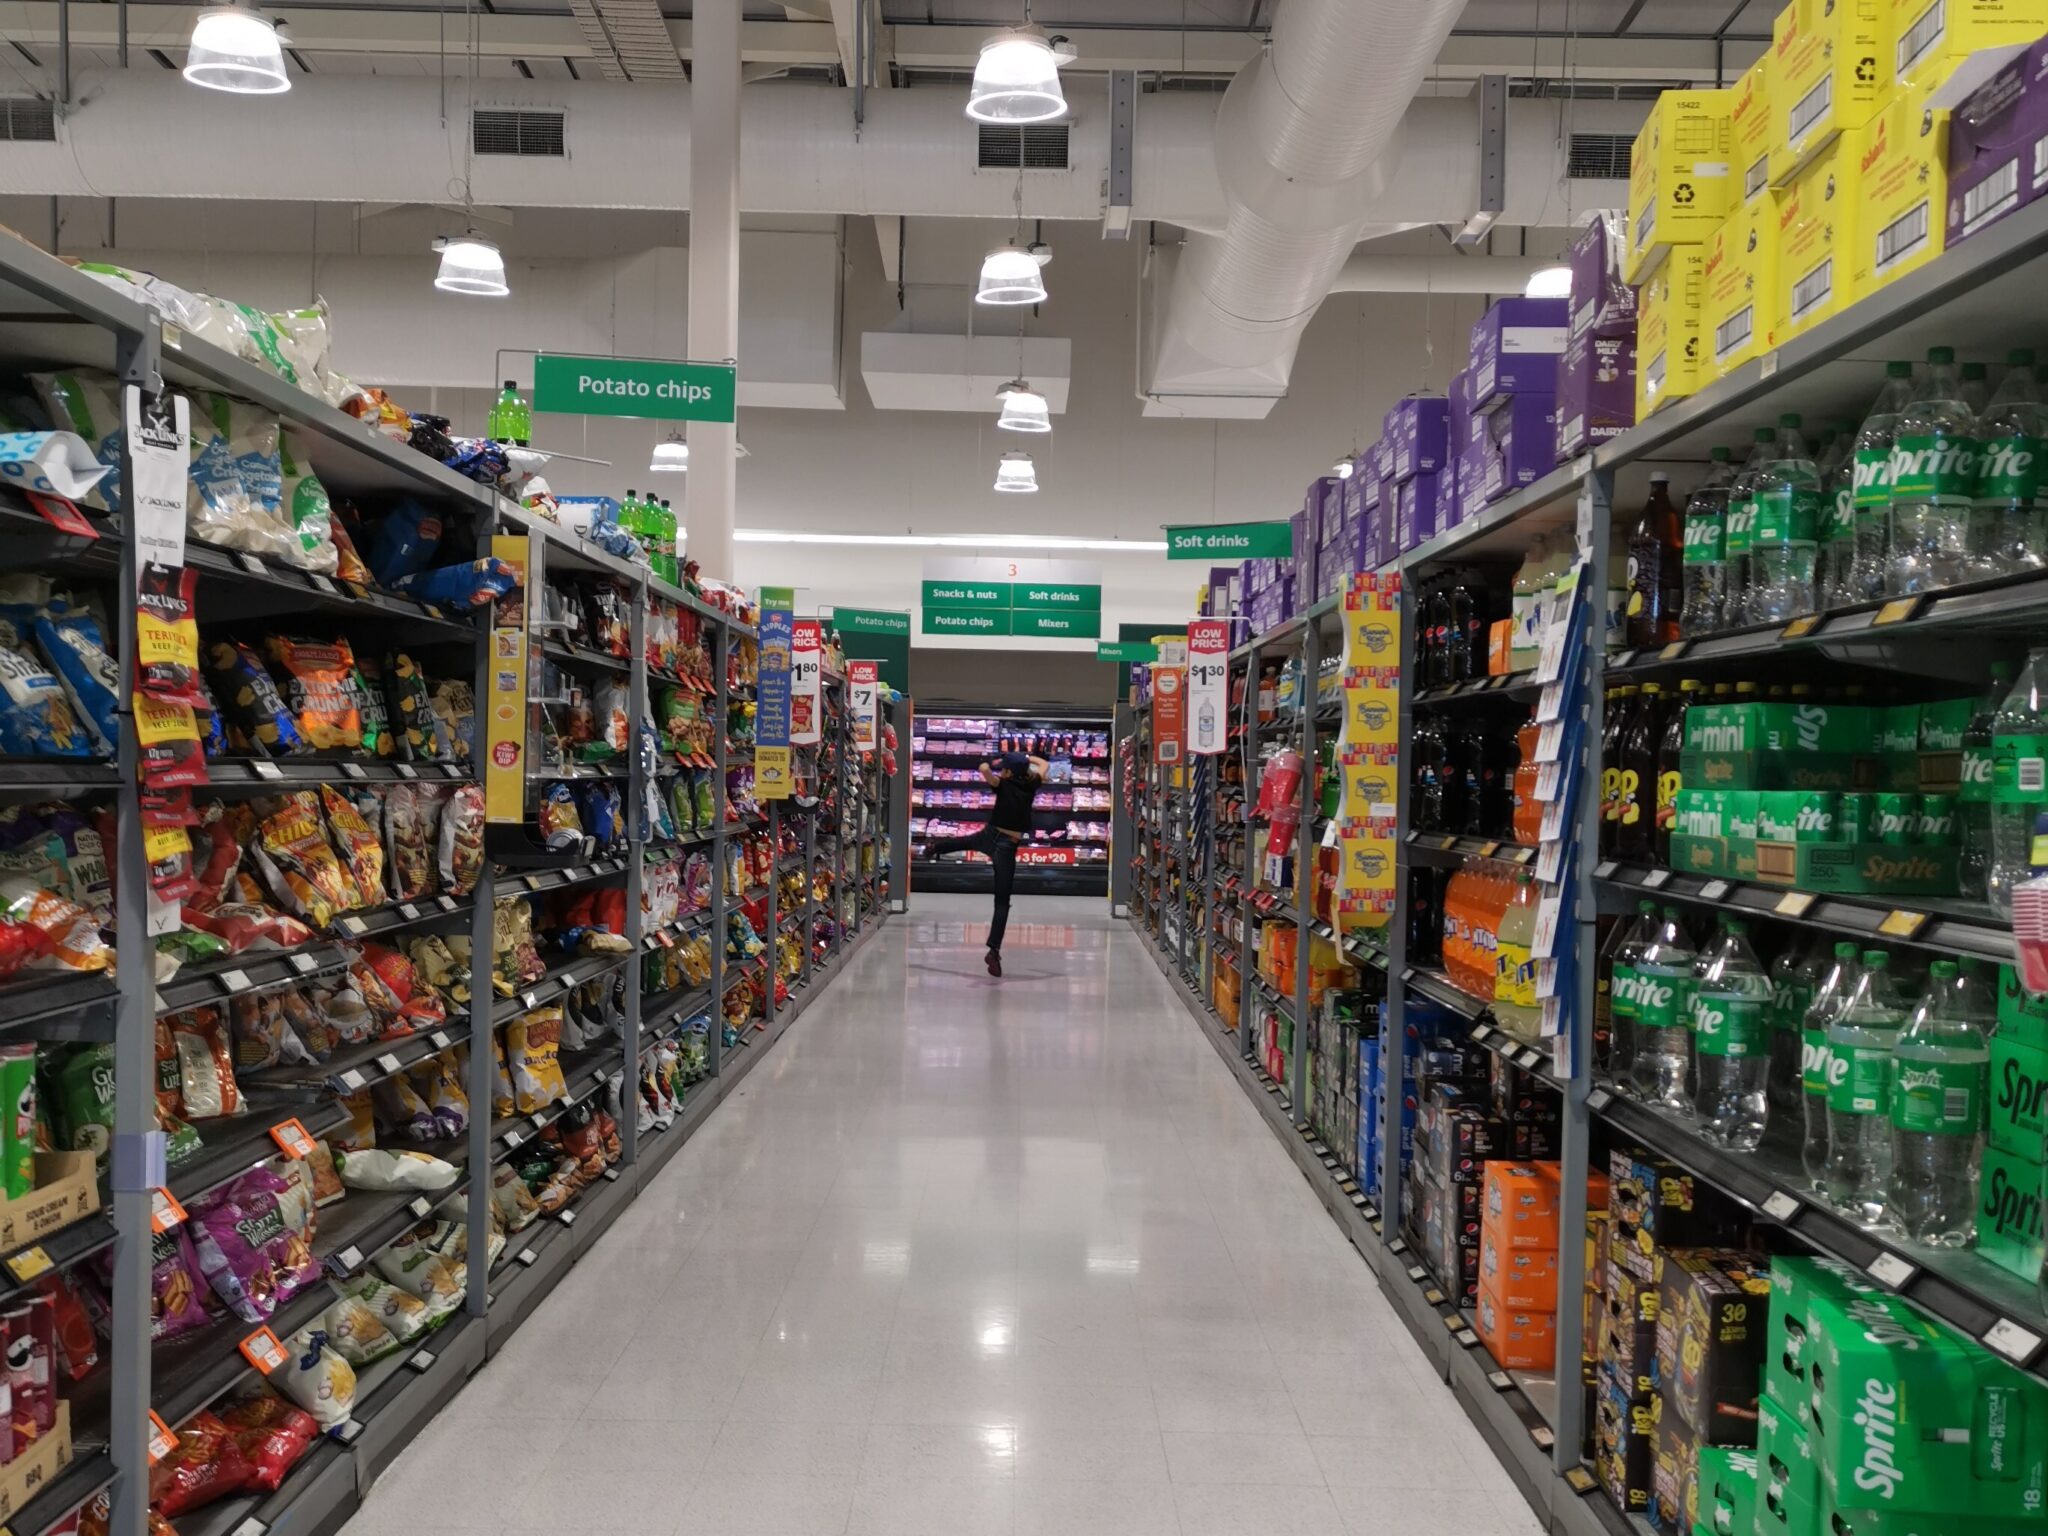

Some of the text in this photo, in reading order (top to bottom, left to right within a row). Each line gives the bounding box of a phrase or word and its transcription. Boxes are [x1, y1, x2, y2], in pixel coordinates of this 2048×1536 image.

[1676, 101, 1701, 110] 15422
[1595, 340, 1622, 348] DAIRY
[578, 375, 712, 403] Potato chips
[1590, 427, 1624, 437] DAIRY
[1977, 442, 2034, 478] rite
[1175, 534, 1250, 548] Soft drinks
[1008, 564, 1018, 577] 3
[933, 588, 998, 600] Snacks & nuts
[1029, 590, 1080, 602] Soft drinks
[765, 598, 777, 607] Try
[761, 622, 791, 634] RIPPLES
[855, 615, 908, 629] Potato chips
[935, 616, 994, 628] Potato chips
[1038, 618, 1070, 629] Mixers
[1194, 628, 1222, 639] LOW
[1100, 647, 1123, 656] Mixers
[1191, 638, 1225, 649] PRICE
[852, 673, 875, 681] PRICE
[854, 690, 871, 706] $7
[1702, 715, 1745, 752] mini
[496, 751, 515, 760] KIWI
[1961, 751, 1993, 782] ite
[1688, 802, 1722, 838] mini
[1796, 806, 1833, 831] ite
[1022, 853, 1030, 862] 3
[1031, 852, 1047, 863] for
[1048, 853, 1067, 863] $20
[1863, 854, 1942, 882] Sprite
[1635, 976, 1674, 1008] ite
[1998, 1057, 2048, 1125] Spr
[26, 1195, 69, 1222] SOUR CREAM
[1984, 1167, 2045, 1236] Spri
[40, 1211, 62, 1228] ONION
[236, 1209, 278, 1234] Grain
[1722, 1303, 1747, 1323] 30
[1988, 1392, 1999, 1438] RECYCLE
[1853, 1378, 1905, 1500] Sprite
[1990, 1439, 2004, 1472] Sprite
[1629, 1488, 1648, 1505] 18
[2023, 1489, 2042, 1511] 18
